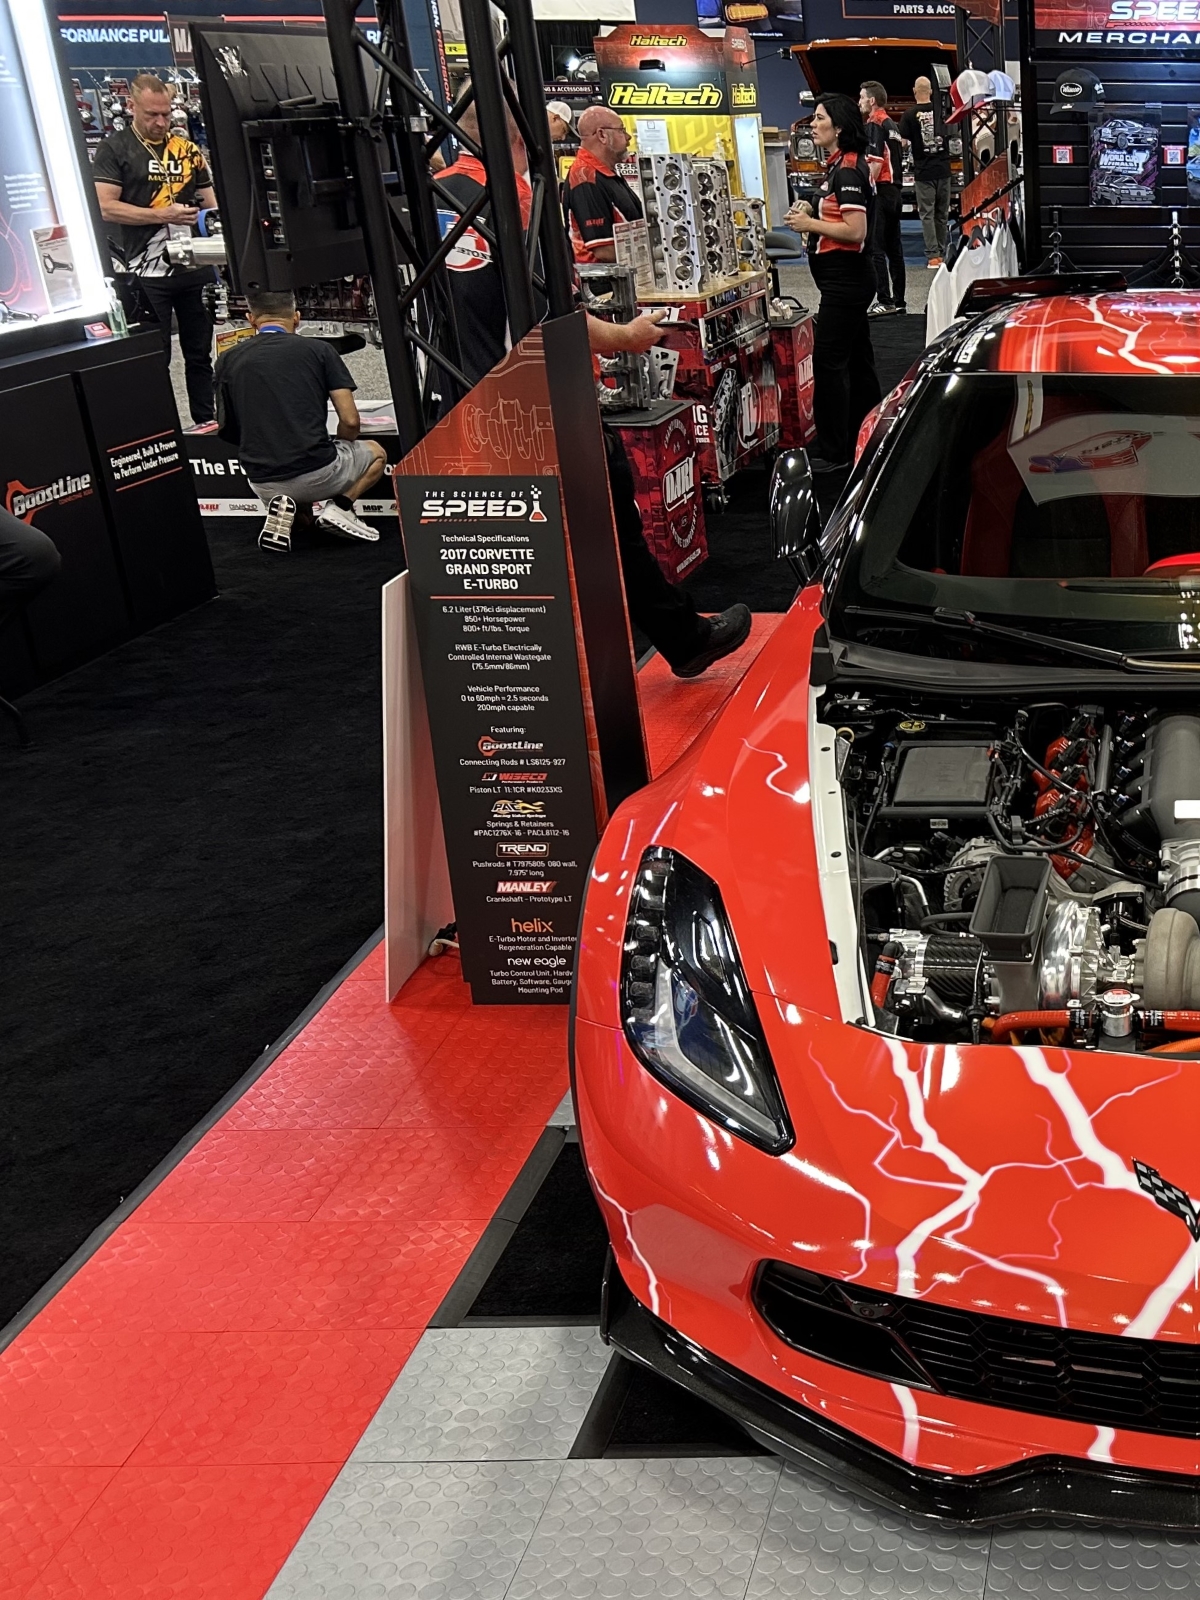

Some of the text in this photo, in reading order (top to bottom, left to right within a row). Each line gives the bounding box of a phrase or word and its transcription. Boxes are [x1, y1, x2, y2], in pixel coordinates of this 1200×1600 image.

[893, 5, 924, 14] PARTS
[927, 5, 934, 14] &
[630, 35, 687, 46] Haltech
[611, 85, 720, 105] Haltech
[732, 84, 756, 106] Haltech
[110, 441, 177, 468] Engineered, Built & Proven
[114, 452, 178, 480] to Perform Under Pressure
[189, 459, 225, 475] The
[13, 474, 91, 516] BoostLine
[421, 500, 527, 516] SPEED
[477, 535, 529, 543] Specifications
[440, 549, 534, 559] 2017 CORVETTE
[446, 564, 532, 574] GRAND SPORT
[464, 579, 518, 589] E-TURBO
[495, 606, 546, 614] displacement)
[503, 644, 542, 652] Electrically
[514, 654, 551, 662] Wastegate
[507, 704, 535, 712] capable
[491, 726, 526, 734] Featuring:
[460, 759, 499, 767] Connecting
[499, 845, 546, 855] TREND
[497, 882, 552, 893] MANLEY
[511, 918, 554, 932] helix
[499, 944, 544, 952] Regeneration
[534, 955, 566, 968] eagle
